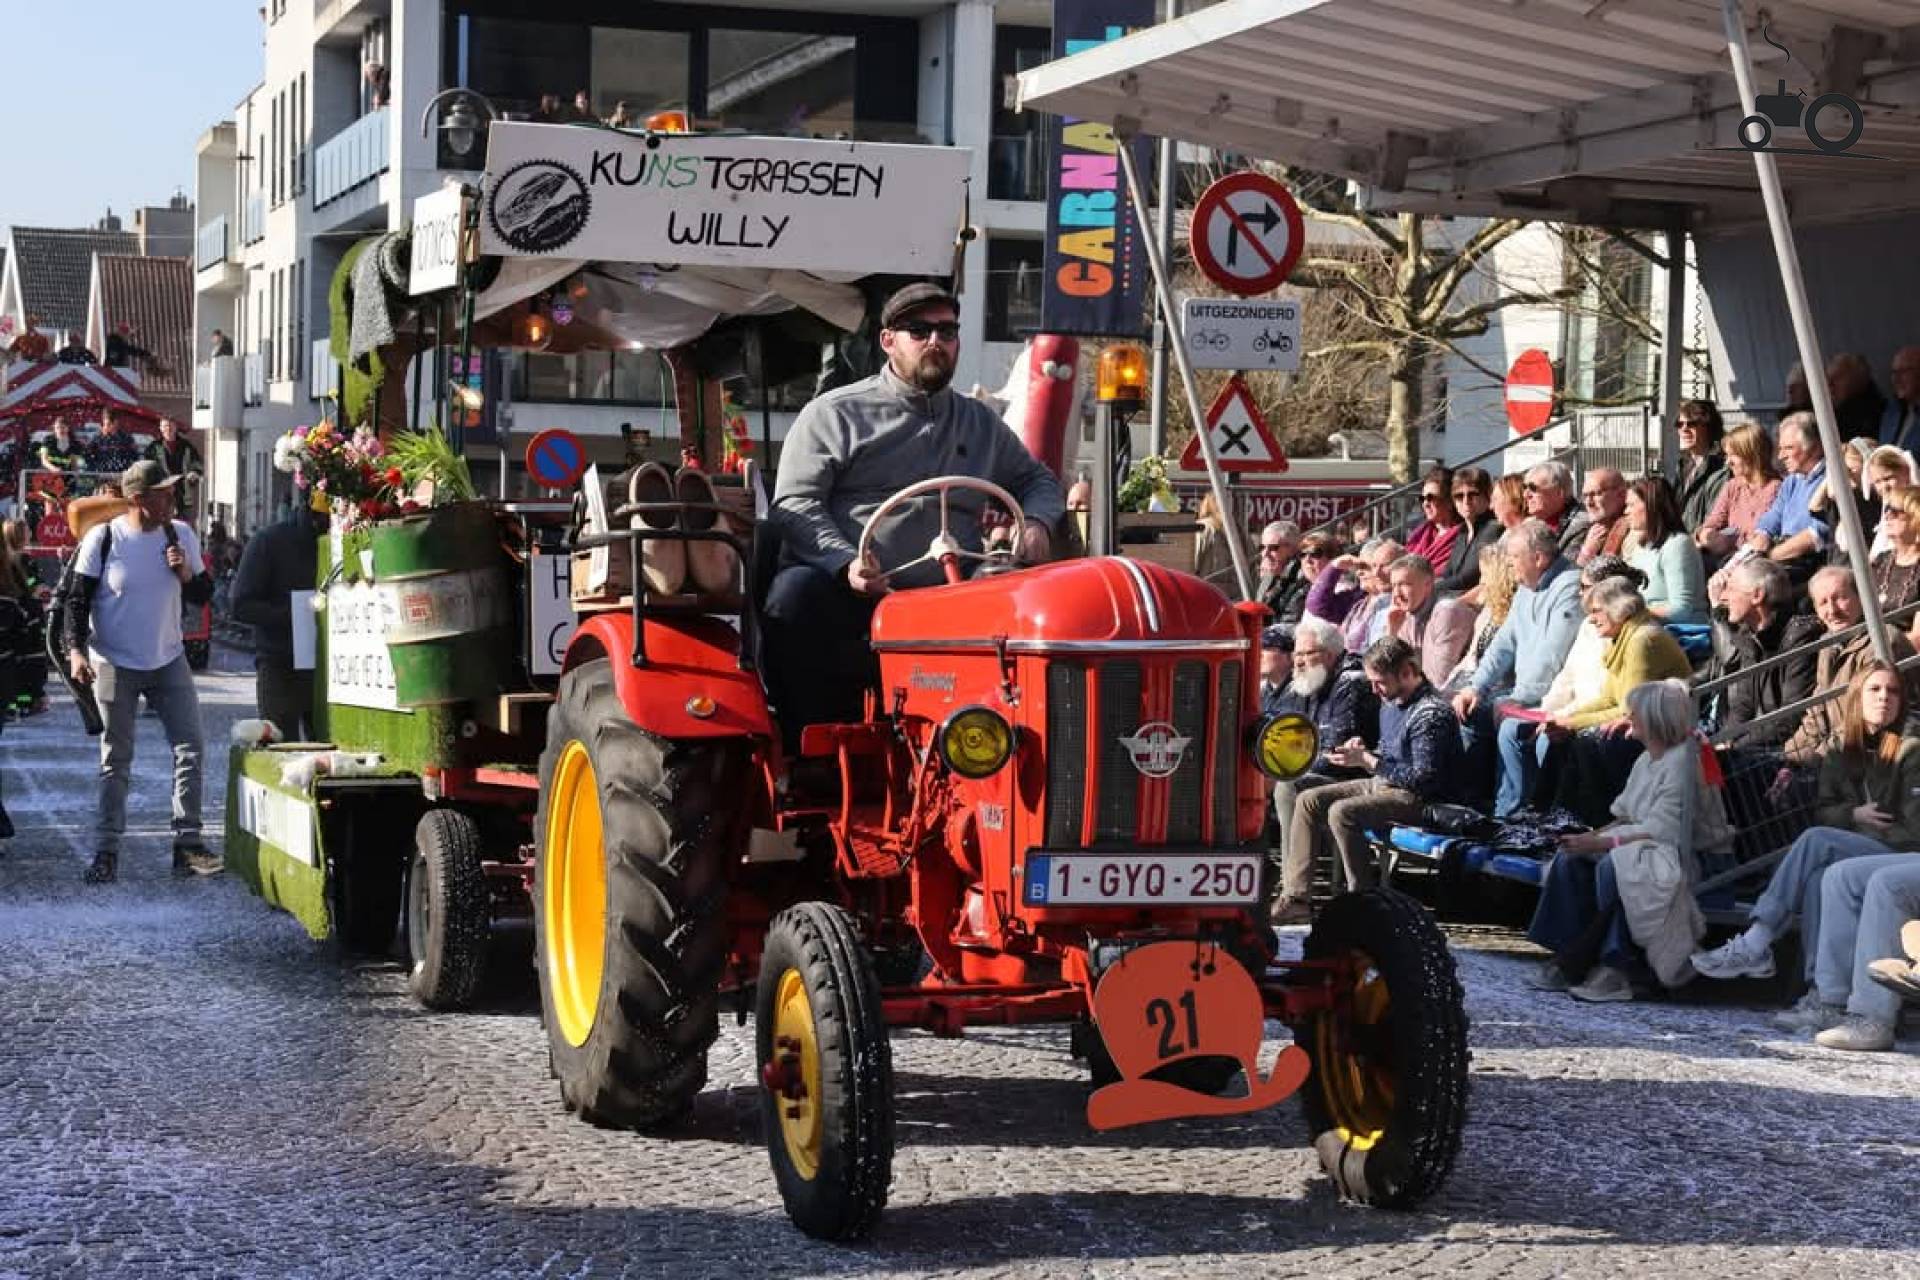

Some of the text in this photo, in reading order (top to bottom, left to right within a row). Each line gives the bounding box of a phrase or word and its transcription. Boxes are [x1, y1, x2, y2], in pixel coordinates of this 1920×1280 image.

[590, 150, 883, 199] KUNSTGRASSEN
[668, 211, 789, 249] WILLY
[1190, 305, 1295, 320] UITGEZONDERD
[1032, 863, 1255, 898] B 1-GYQ-250
[1146, 989, 1199, 1058] 21
